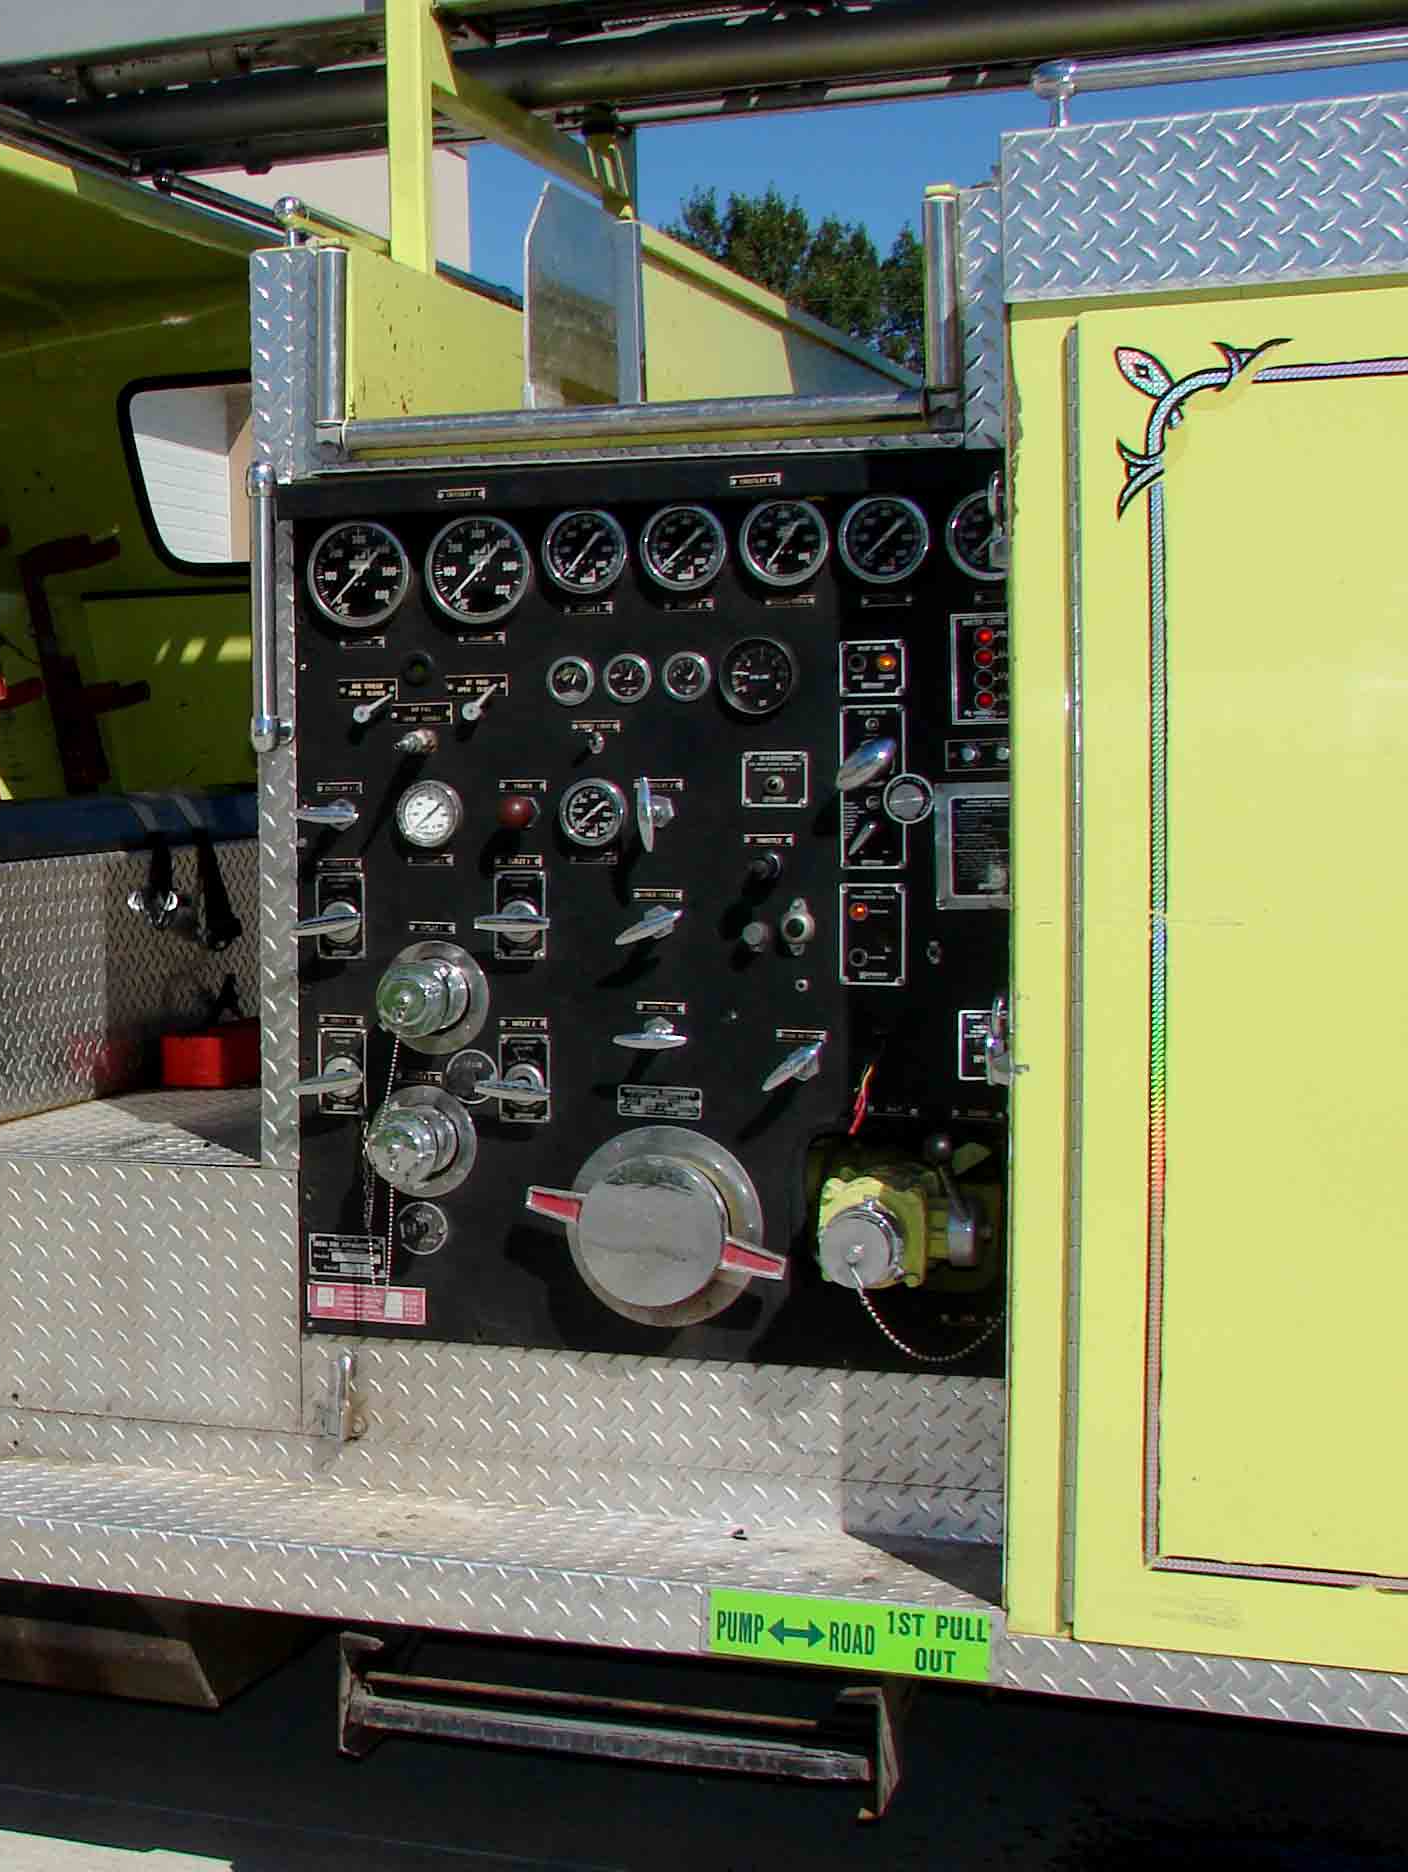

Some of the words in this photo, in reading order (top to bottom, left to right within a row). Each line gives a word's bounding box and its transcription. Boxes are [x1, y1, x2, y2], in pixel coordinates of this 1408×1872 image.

[716, 1609, 765, 1645] PUMP
[829, 1621, 876, 1656] ROAD
[887, 1610, 926, 1638] 1ST
[935, 1613, 989, 1644] PULL
[914, 1647, 957, 1674] OUT
